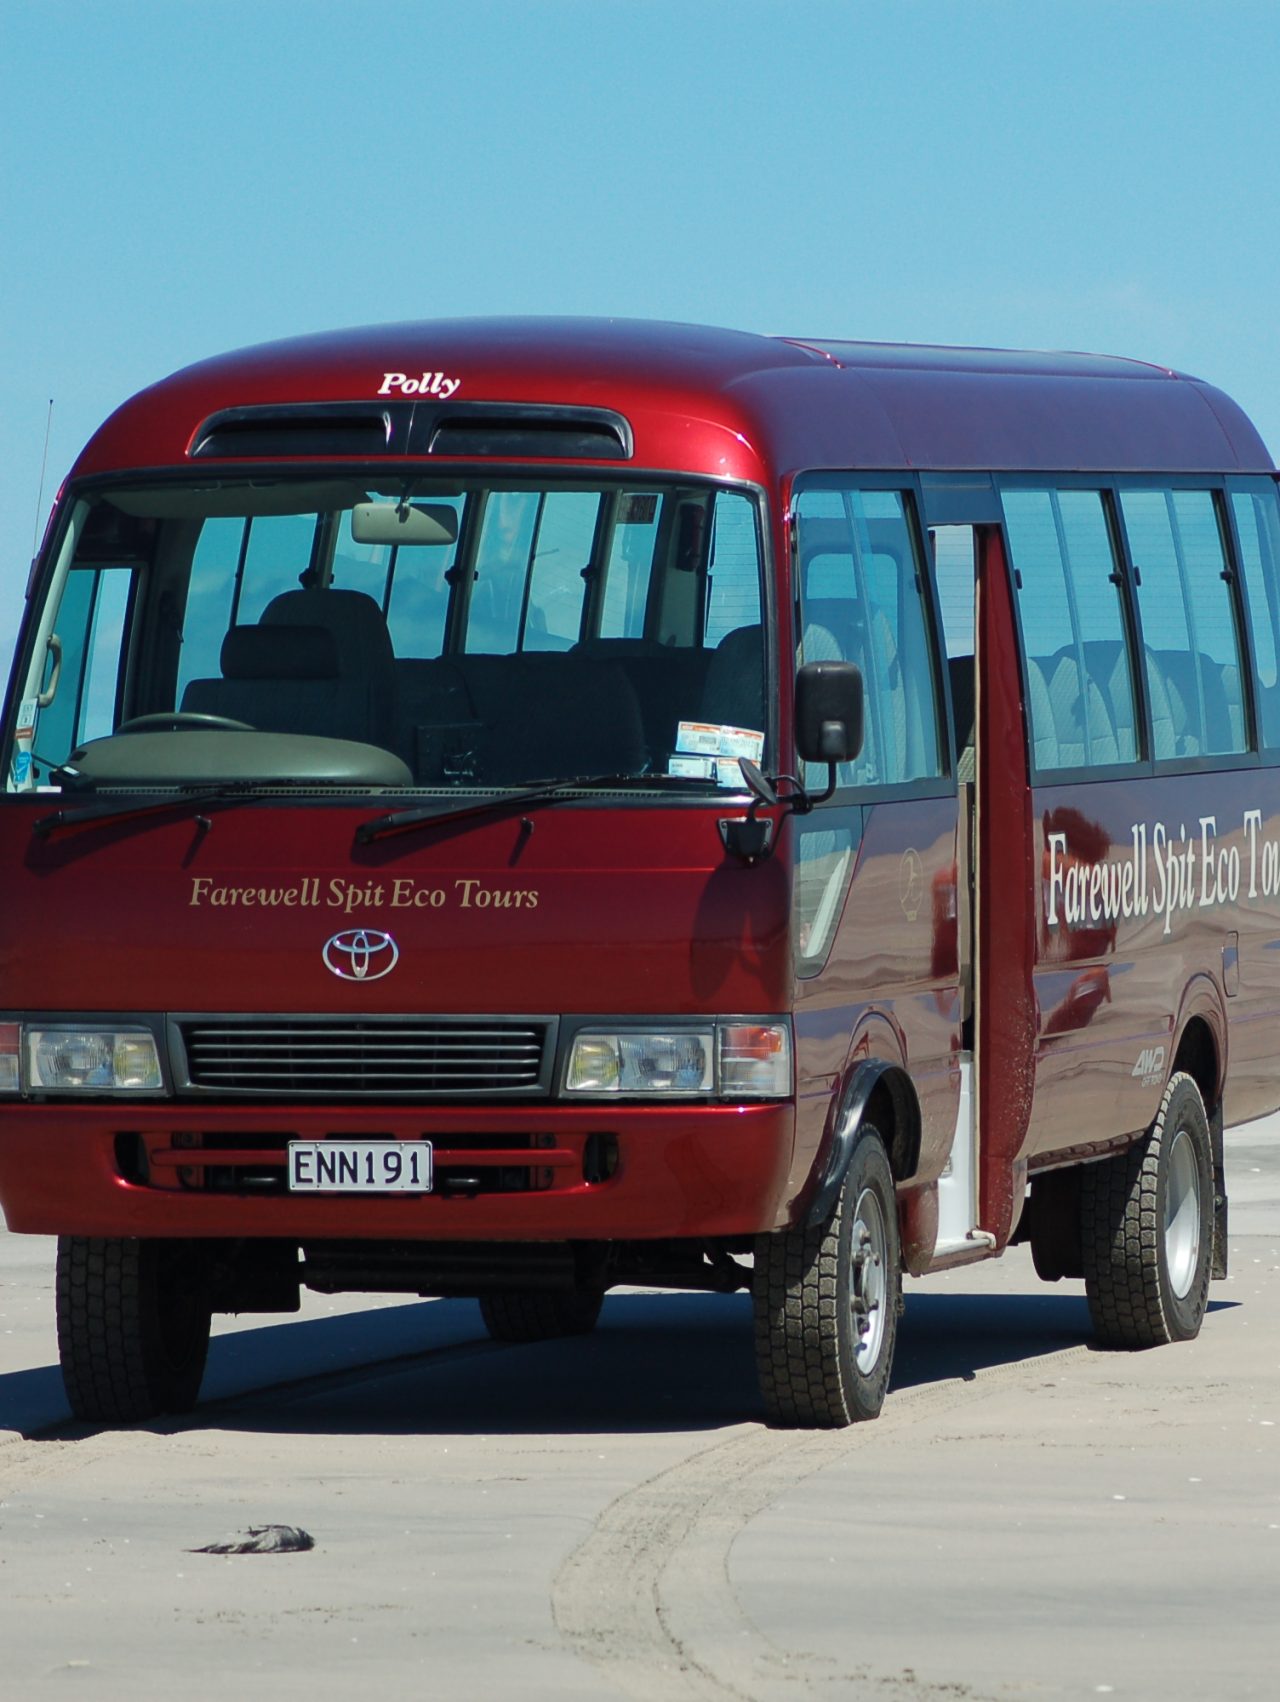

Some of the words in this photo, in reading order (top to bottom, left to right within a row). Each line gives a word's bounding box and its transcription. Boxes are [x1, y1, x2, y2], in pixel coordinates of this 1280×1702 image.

[377, 371, 461, 399] Polly
[1047, 822, 1149, 925] Farewell
[1152, 821, 1196, 934] Spit
[1198, 815, 1240, 907] Eco
[189, 877, 320, 907] Farewell
[326, 878, 385, 914] Spit
[390, 879, 446, 908] Eco
[454, 880, 540, 909] Tours
[294, 1150, 420, 1184] ENN191
